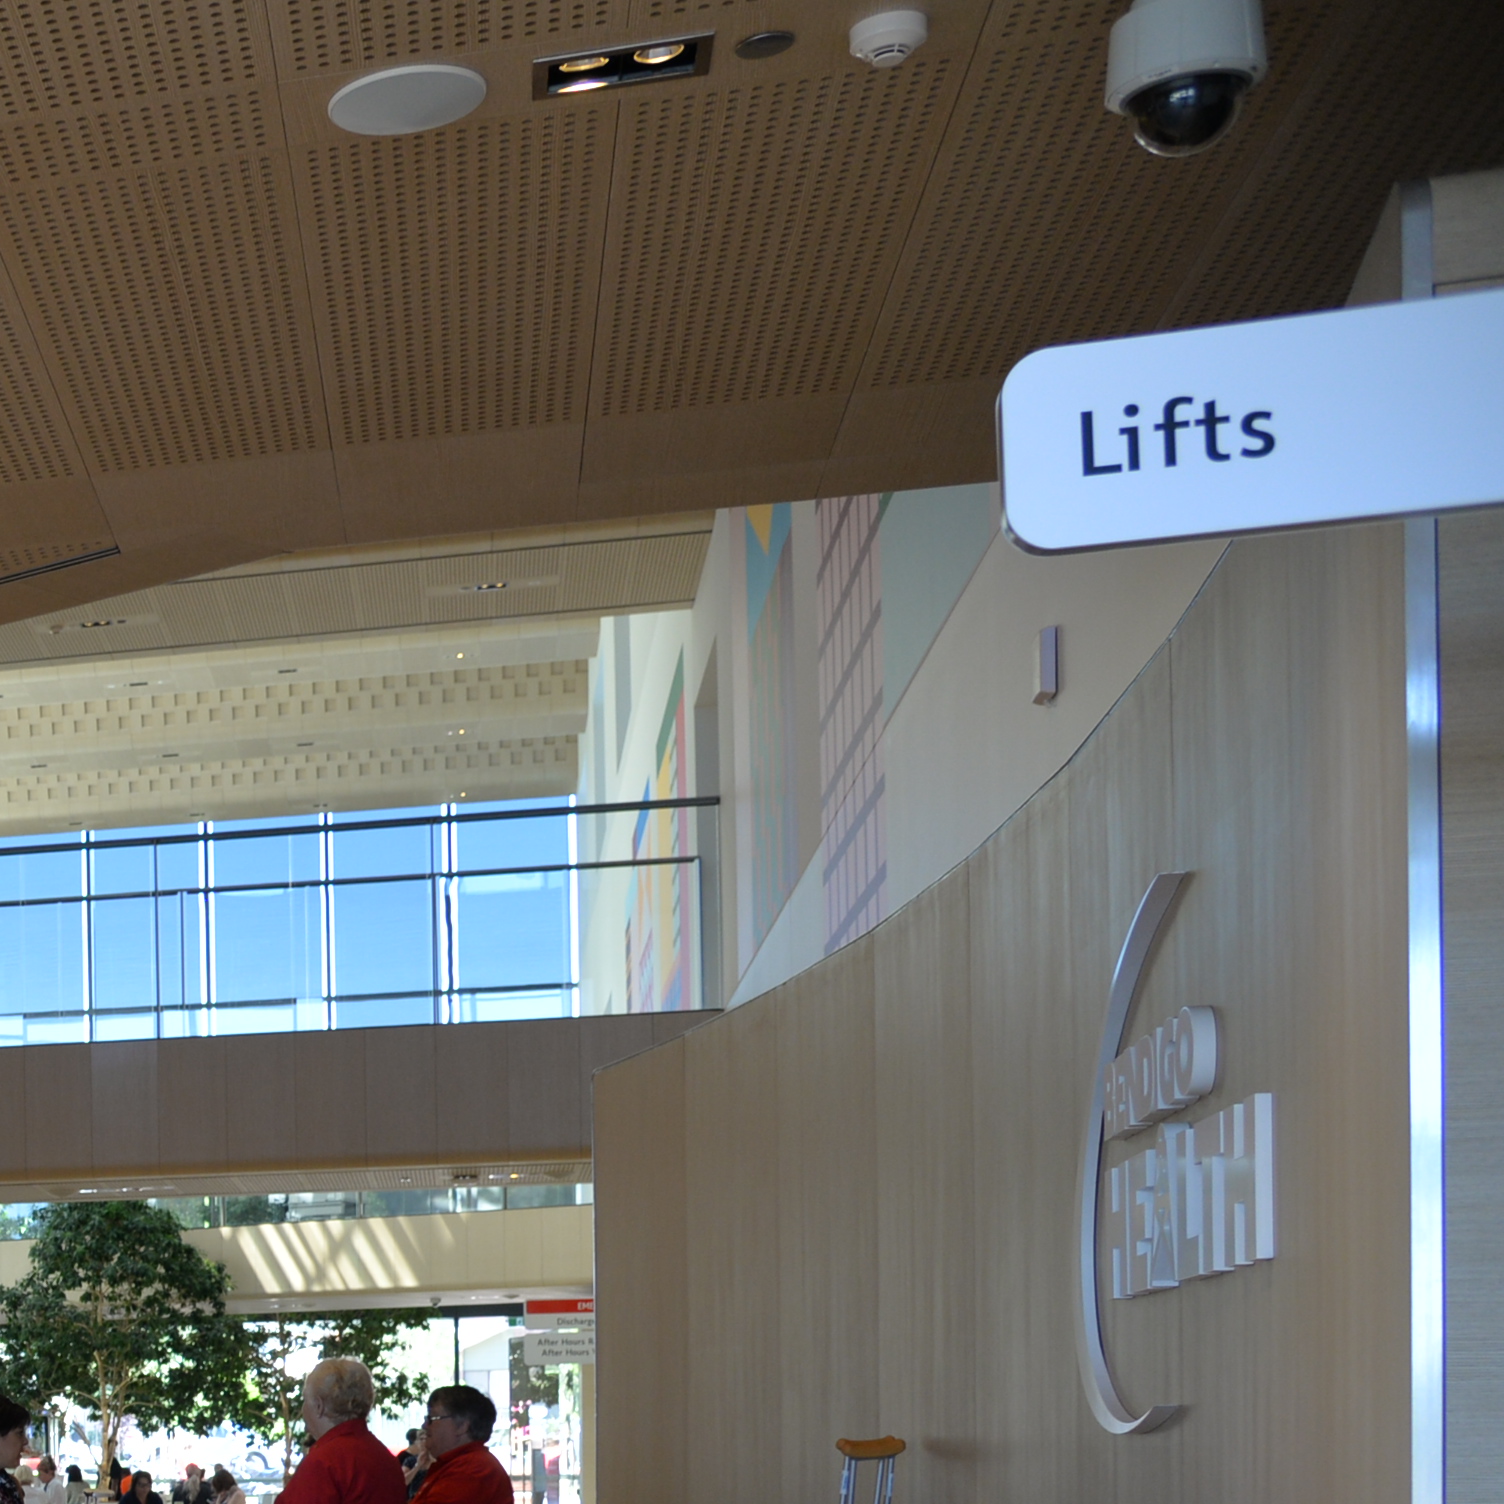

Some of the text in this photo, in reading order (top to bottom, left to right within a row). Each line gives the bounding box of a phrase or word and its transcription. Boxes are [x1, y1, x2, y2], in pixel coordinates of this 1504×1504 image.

[1079, 395, 1277, 477] Lifts
[1103, 1004, 1218, 1142] BENDIGO
[1104, 1091, 1276, 1300] HEALTH
[537, 1338, 559, 1347] After
[561, 1337, 585, 1346] Hours
